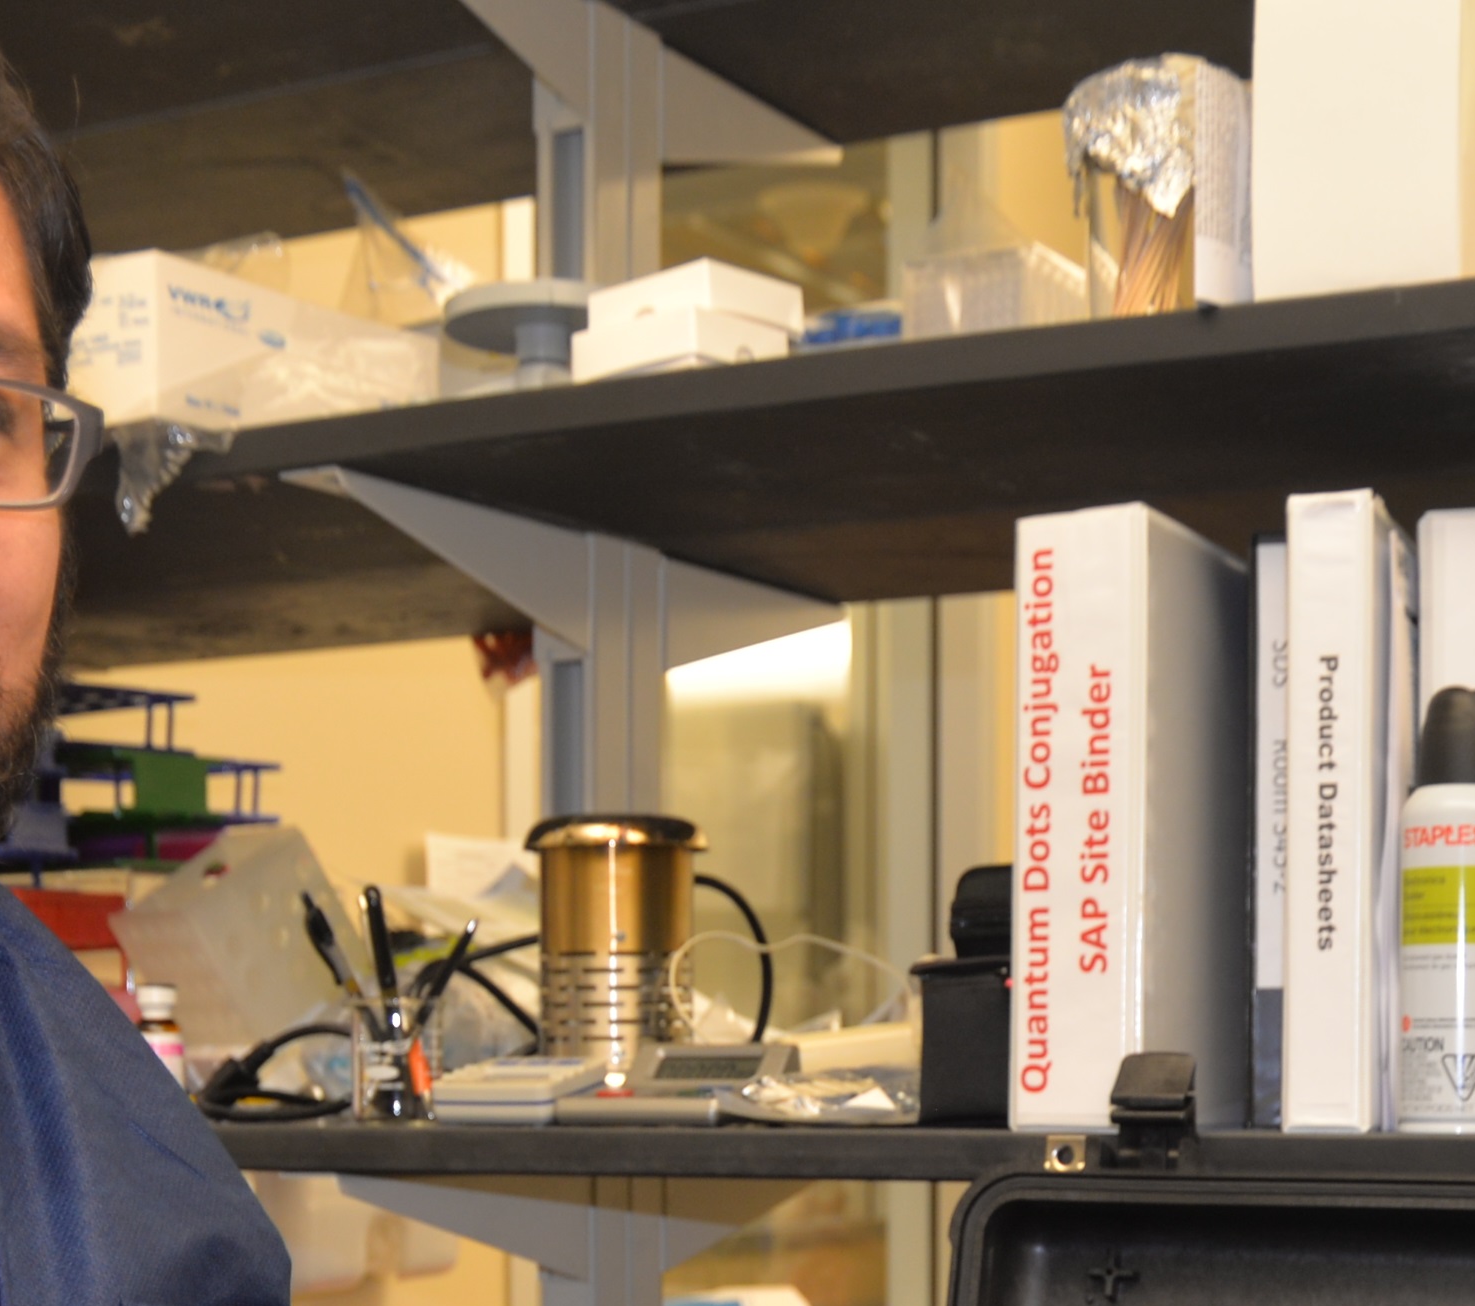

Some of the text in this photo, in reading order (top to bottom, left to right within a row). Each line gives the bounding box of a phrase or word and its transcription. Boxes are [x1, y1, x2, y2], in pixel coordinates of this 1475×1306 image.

[1021, 547, 1059, 1093] Quantum Dots Conjugation
[1080, 664, 1112, 974] SAP Site Binder
[1317, 654, 1339, 953] Product Datasheets
